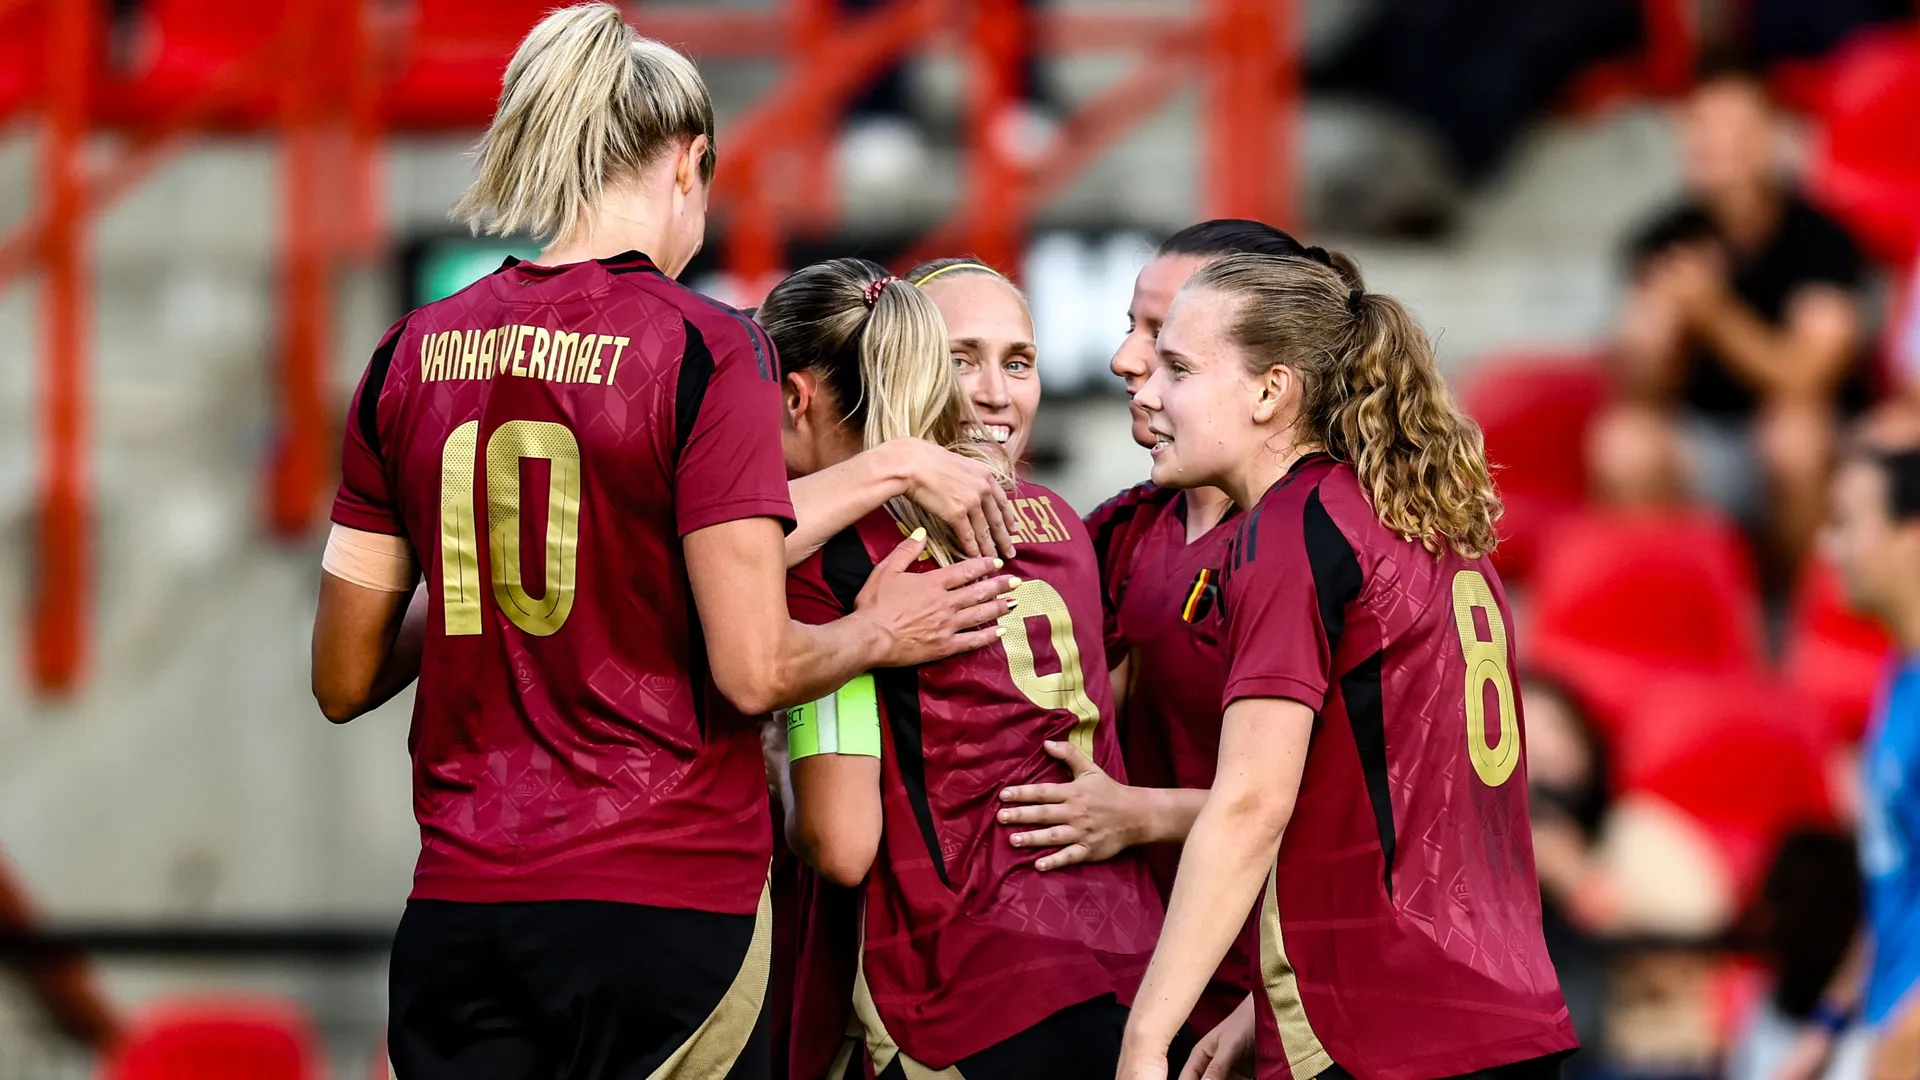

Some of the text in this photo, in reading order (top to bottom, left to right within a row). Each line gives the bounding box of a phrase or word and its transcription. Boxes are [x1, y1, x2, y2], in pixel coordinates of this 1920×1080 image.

[441, 420, 581, 636] 10
[1008, 495, 1071, 544] AERT
[998, 579, 1099, 761] 9
[1452, 570, 1520, 787] 8
